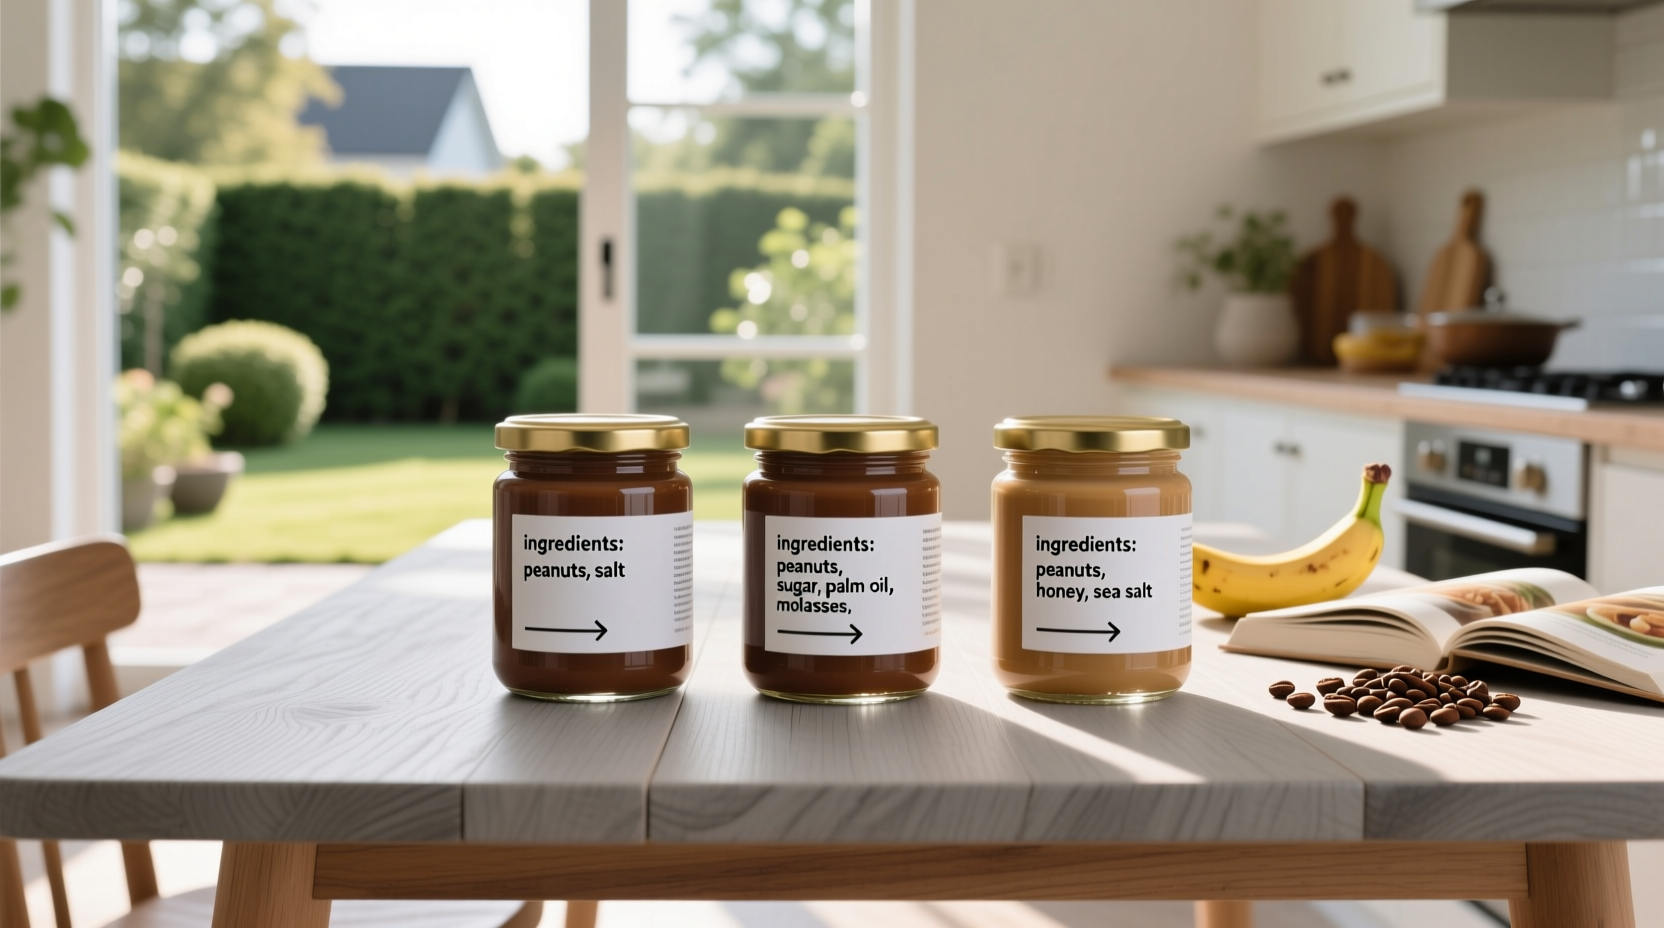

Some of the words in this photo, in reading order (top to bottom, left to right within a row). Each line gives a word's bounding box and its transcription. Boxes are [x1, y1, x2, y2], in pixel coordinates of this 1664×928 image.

[524, 534, 623, 555] ingredients:
[777, 534, 874, 555] ingredients:
[1036, 535, 1136, 556] ingredients:
[524, 563, 590, 581] peanuts,
[595, 561, 625, 578] salt
[777, 560, 842, 577] peanuts,
[1036, 563, 1105, 580] peanuts,
[777, 580, 821, 597] sugar,
[826, 578, 864, 598] palm
[870, 577, 893, 595] oil,
[1037, 582, 1088, 602] honey,
[1094, 587, 1121, 599] sea
[1126, 582, 1152, 598] salt
[777, 598, 851, 614] molasses,
